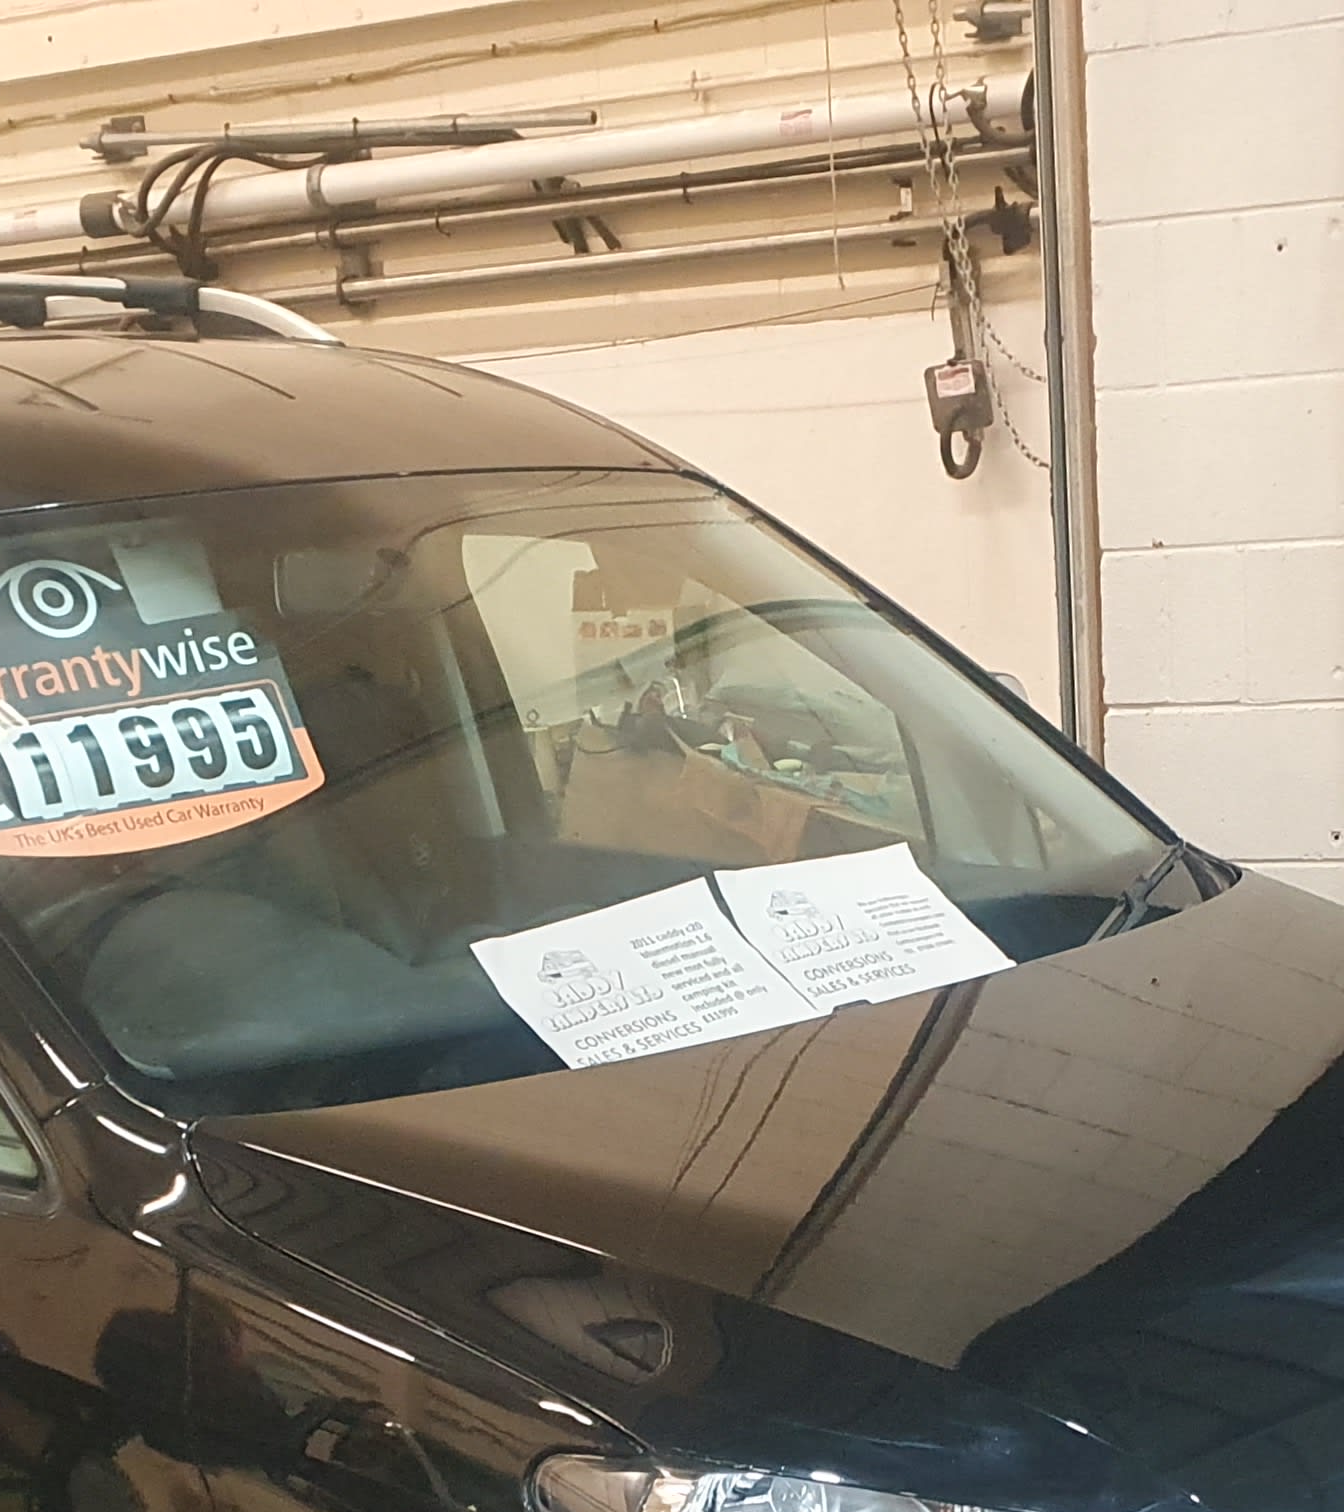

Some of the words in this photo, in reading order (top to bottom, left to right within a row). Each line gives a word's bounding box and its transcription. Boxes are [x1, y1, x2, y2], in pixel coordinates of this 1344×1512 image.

[14, 832, 47, 850] The
[49, 826, 84, 844] UK's
[86, 819, 122, 839] Best
[123, 810, 164, 831] Used
[166, 807, 193, 824] Car
[196, 796, 265, 819] Warranty
[803, 950, 895, 982] CONVERSIONS
[807, 979, 848, 999] SALES
[847, 976, 860, 987] &
[858, 962, 916, 985] SERVICES
[574, 1009, 679, 1051] CONVERSIONS
[621, 1042, 637, 1056] &
[635, 1020, 703, 1051] SERVICES
